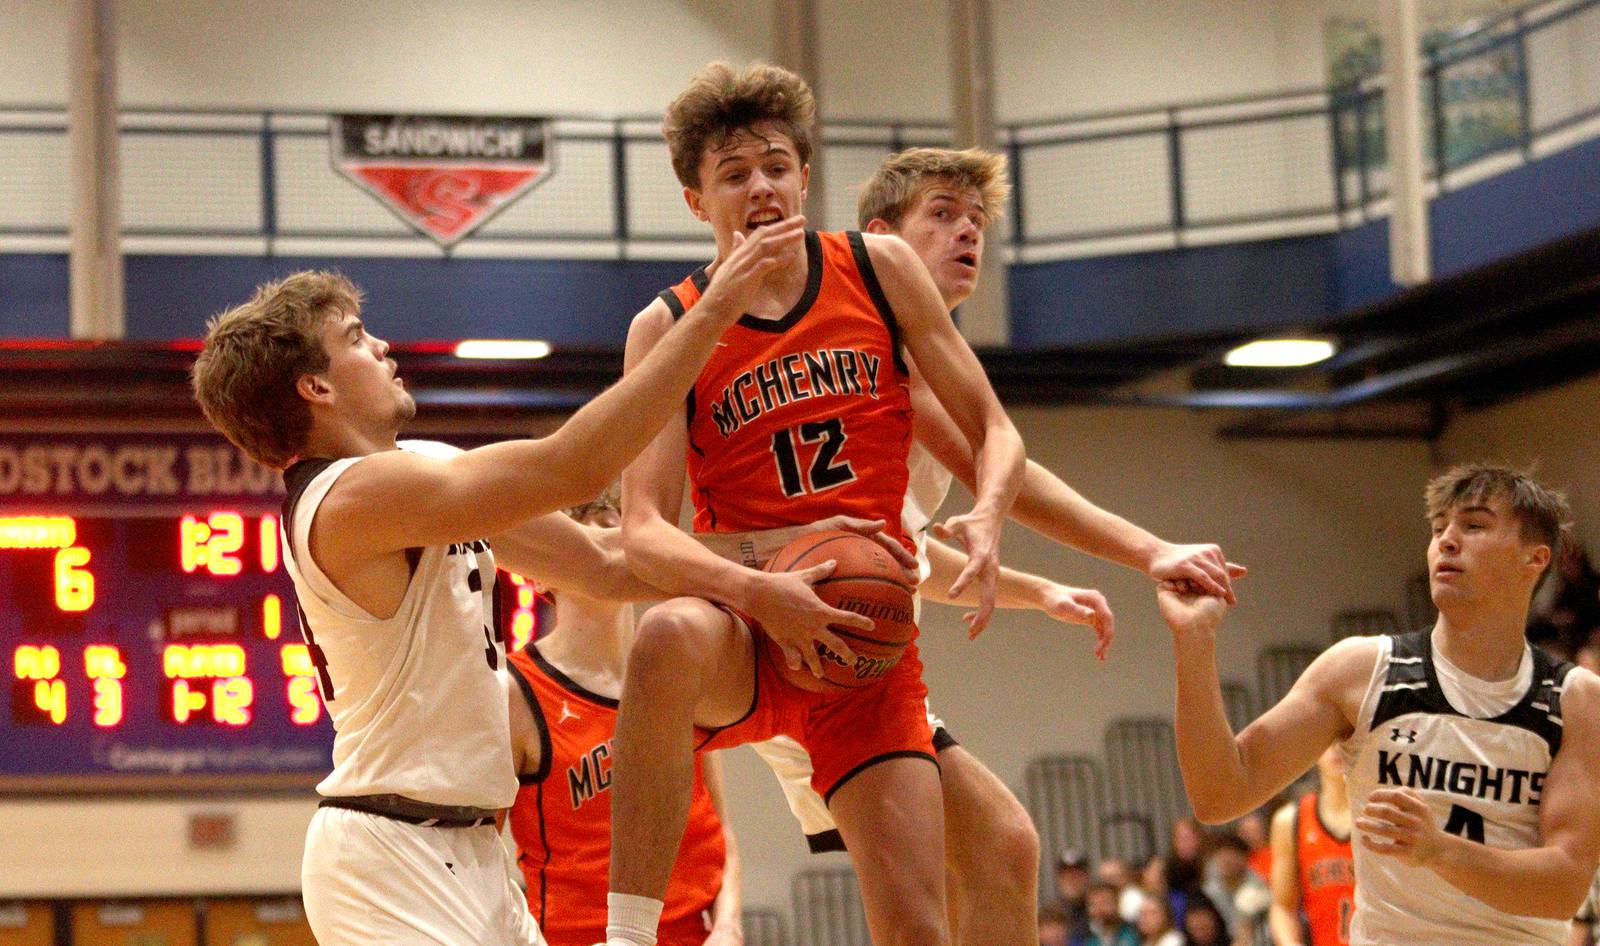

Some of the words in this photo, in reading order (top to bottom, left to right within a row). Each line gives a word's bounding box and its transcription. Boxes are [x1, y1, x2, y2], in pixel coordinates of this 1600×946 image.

[362, 123, 524, 156] SANDWICH
[711, 348, 881, 440] MCHENRY
[770, 417, 858, 499] 12
[54, 546, 95, 612] 6
[262, 592, 282, 640] 1
[34, 678, 67, 725] 4
[93, 677, 123, 727] 3
[566, 738, 615, 811] MC
[1377, 749, 1548, 807] KNIGHTS
